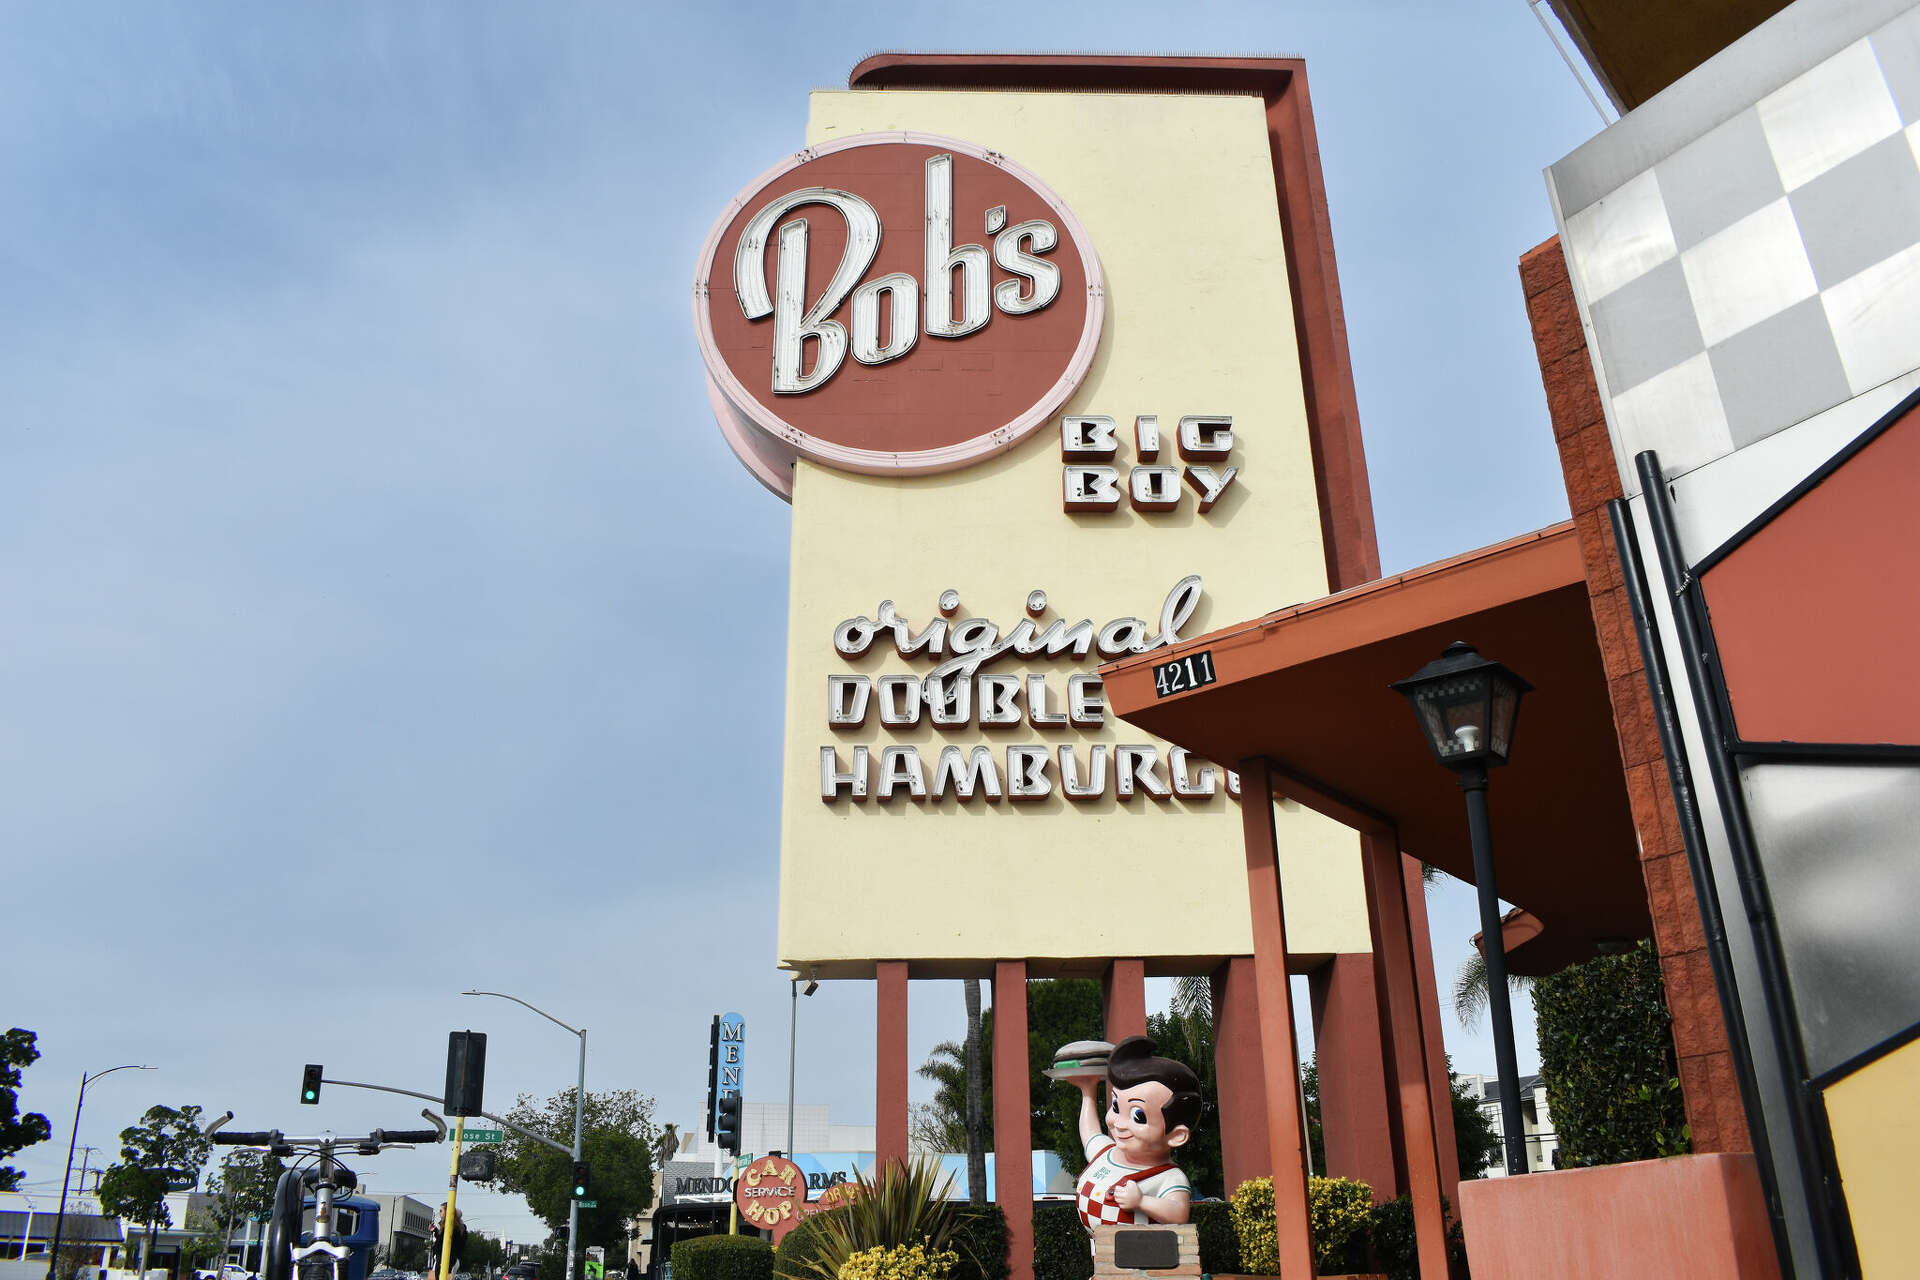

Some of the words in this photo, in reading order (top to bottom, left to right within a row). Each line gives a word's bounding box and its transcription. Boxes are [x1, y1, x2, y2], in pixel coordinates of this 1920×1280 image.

[733, 153, 1061, 395] Bob's
[1061, 415, 1234, 463] BIG
[1062, 465, 1239, 515] BOY
[833, 574, 1202, 705] original
[1156, 653, 1215, 695] 4211
[827, 673, 1104, 731] DOUBLE
[819, 744, 1241, 803] HAMBURG
[744, 1186, 796, 1199] SERVICE
[746, 1159, 797, 1187] CAR
[808, 1171, 847, 1190] RMS
[745, 1199, 794, 1226] HOP
